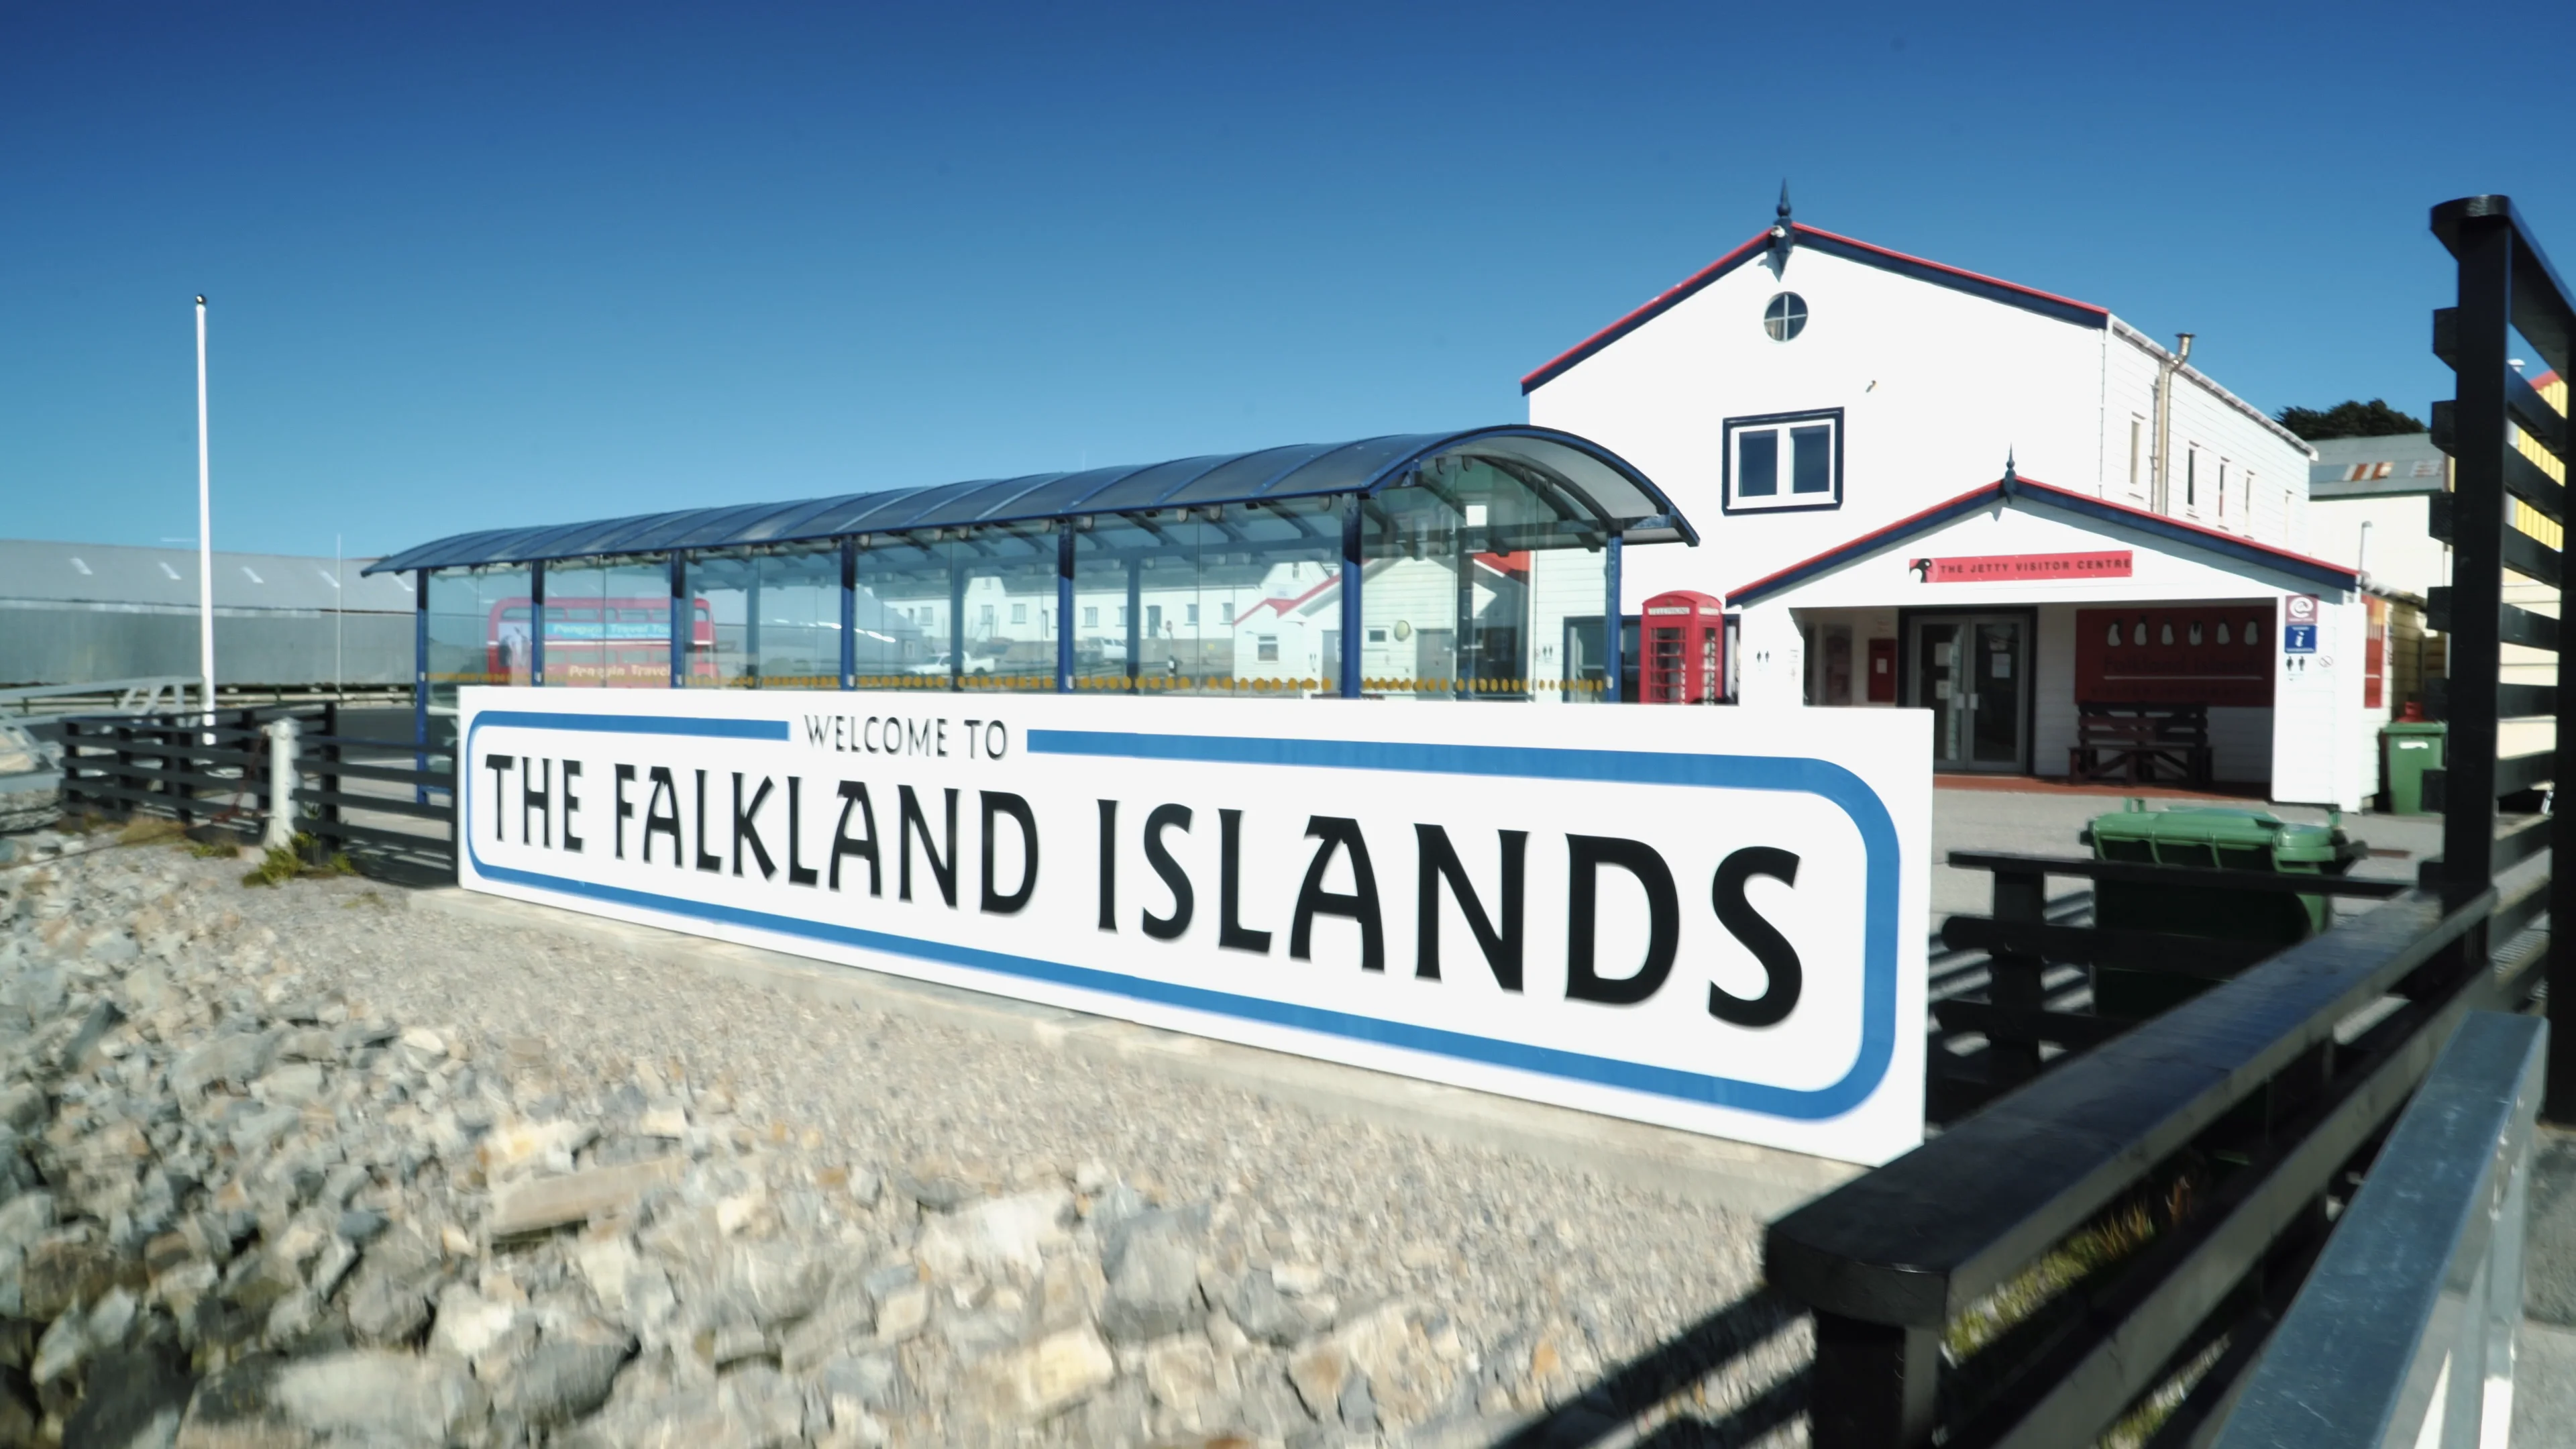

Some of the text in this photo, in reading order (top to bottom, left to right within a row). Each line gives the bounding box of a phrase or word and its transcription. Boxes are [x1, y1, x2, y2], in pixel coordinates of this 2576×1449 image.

[1940, 558, 2131, 574] THE JETTY VISITOR CENTRE
[631, 664, 670, 677] Travel
[805, 715, 1007, 760] WELCOME TO
[484, 754, 1803, 1029] THE FALKLAND ISLANDS
